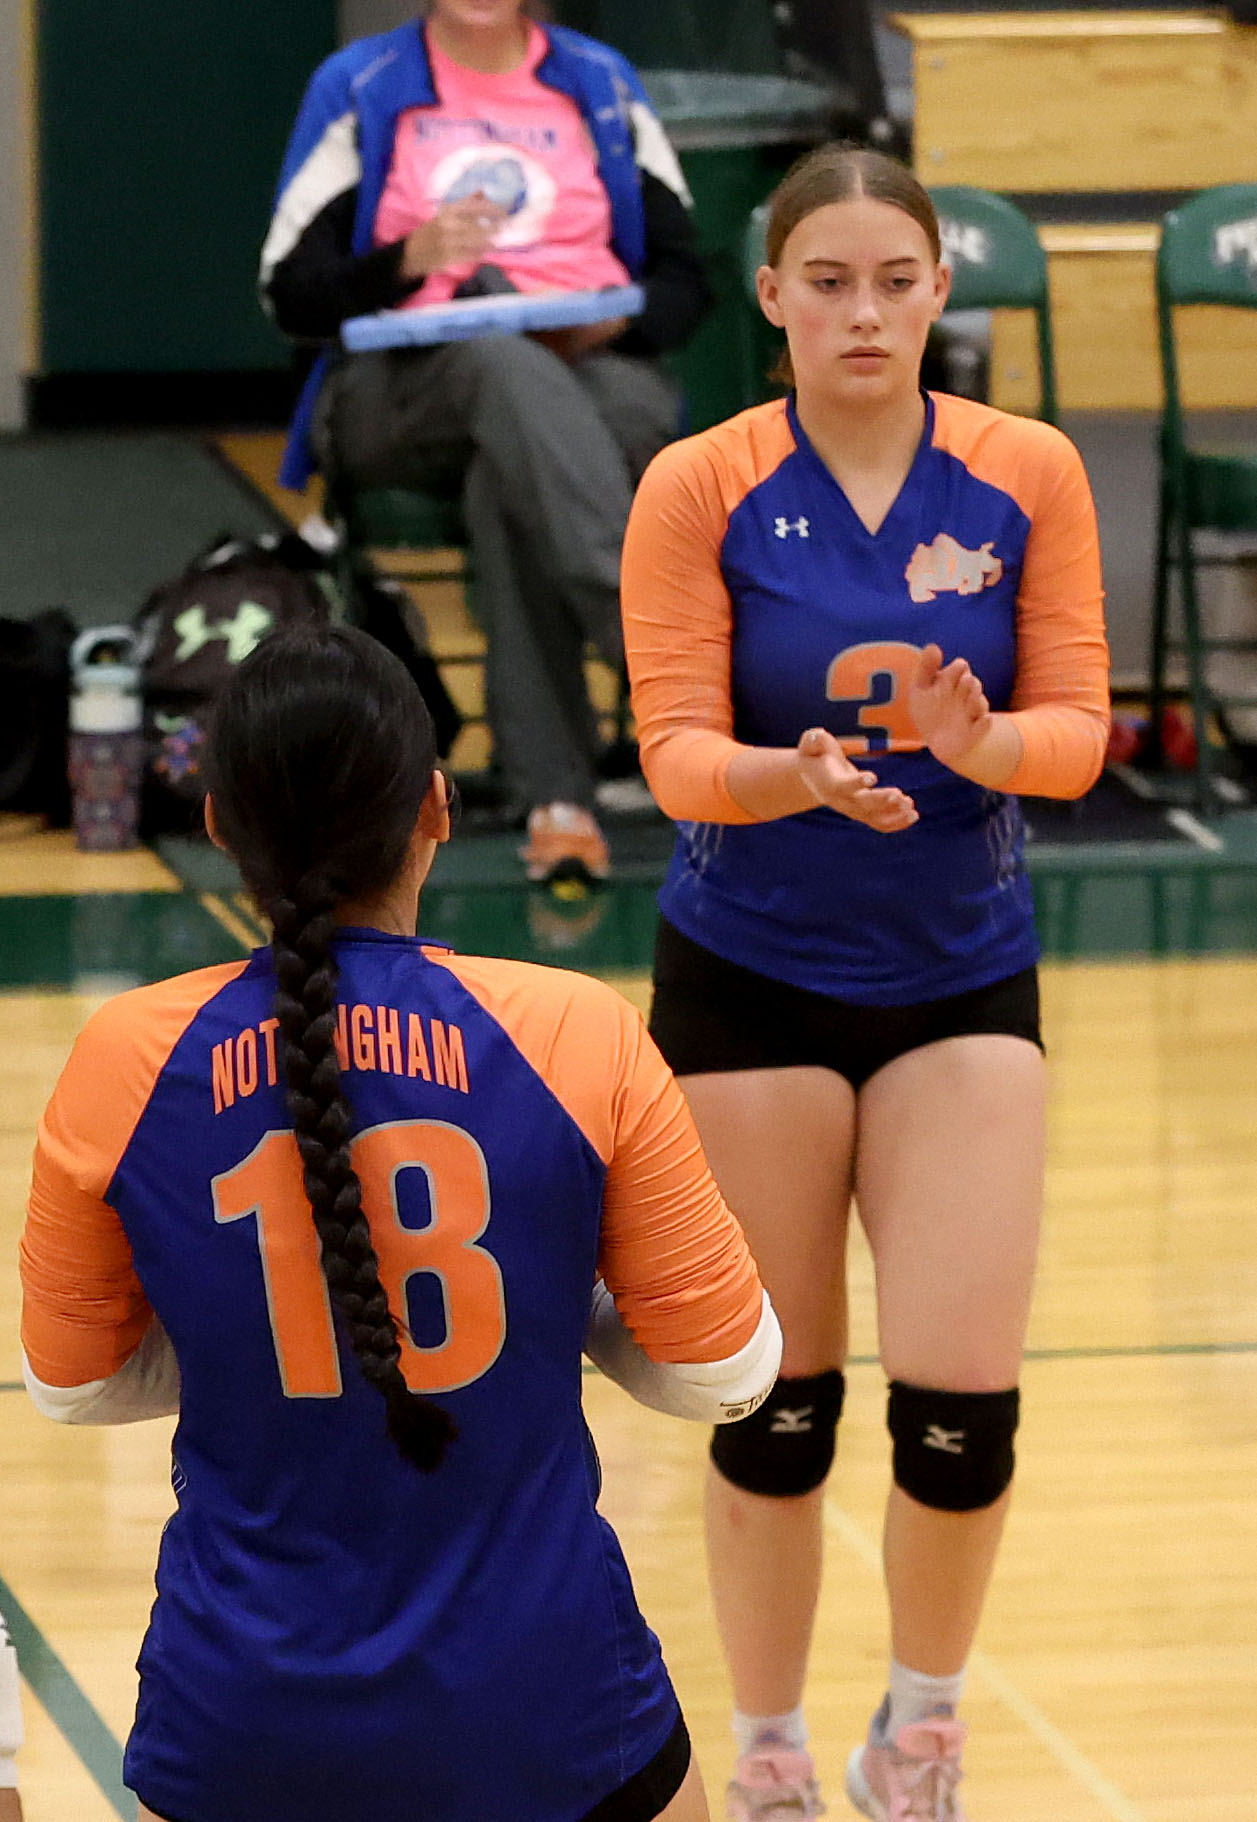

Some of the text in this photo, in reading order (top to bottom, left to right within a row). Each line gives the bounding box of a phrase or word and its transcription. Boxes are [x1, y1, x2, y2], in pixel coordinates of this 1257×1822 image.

[826, 640, 928, 755] 3
[210, 1003, 470, 1115] NOTNGHAM
[210, 1118, 507, 1399] 18
